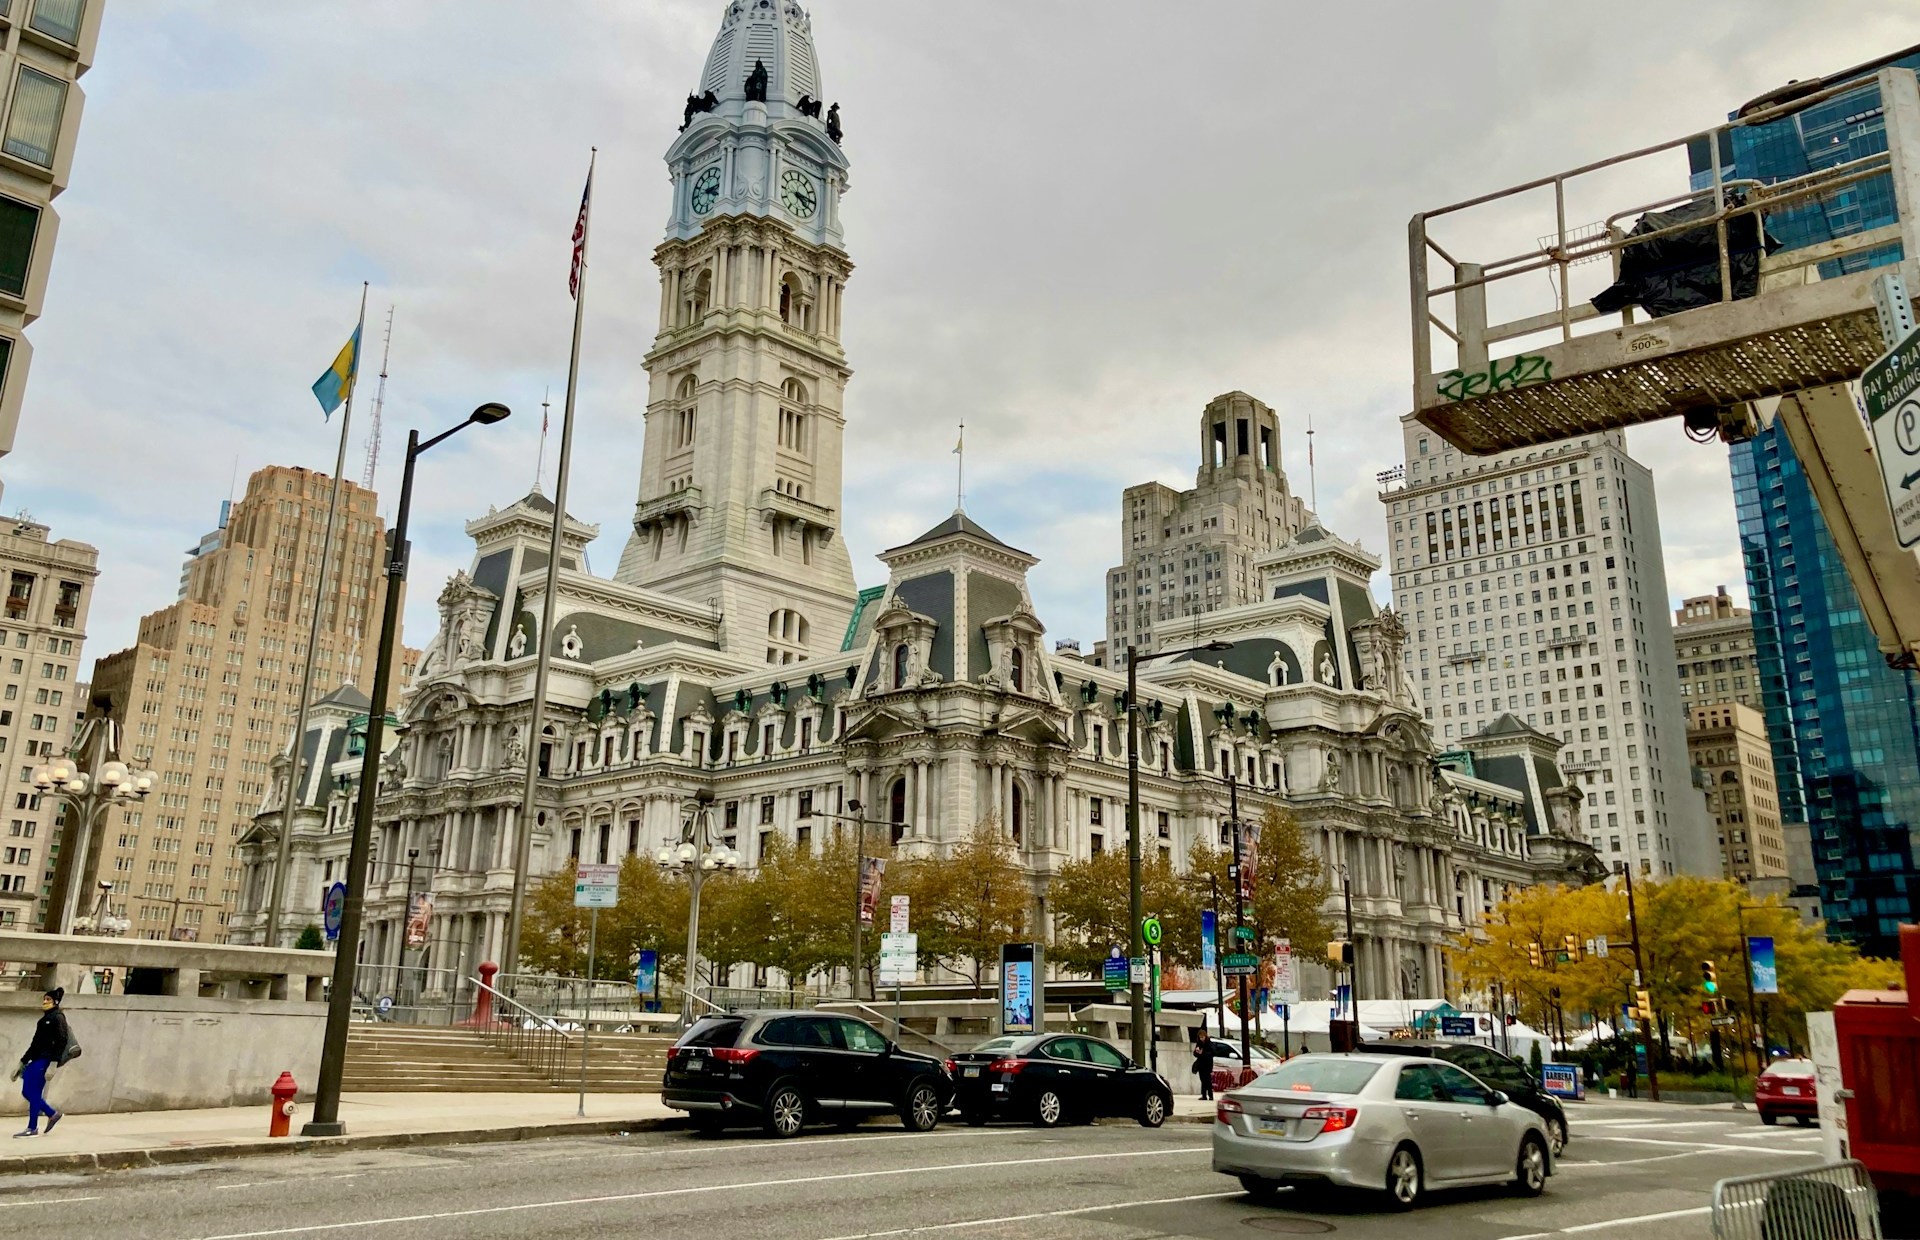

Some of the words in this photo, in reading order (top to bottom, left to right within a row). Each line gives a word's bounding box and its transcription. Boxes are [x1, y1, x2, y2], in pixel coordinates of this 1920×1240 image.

[1631, 340, 1651, 351] 500
[1864, 376, 1882, 400] PAY
[1880, 367, 1920, 410] PARKING
